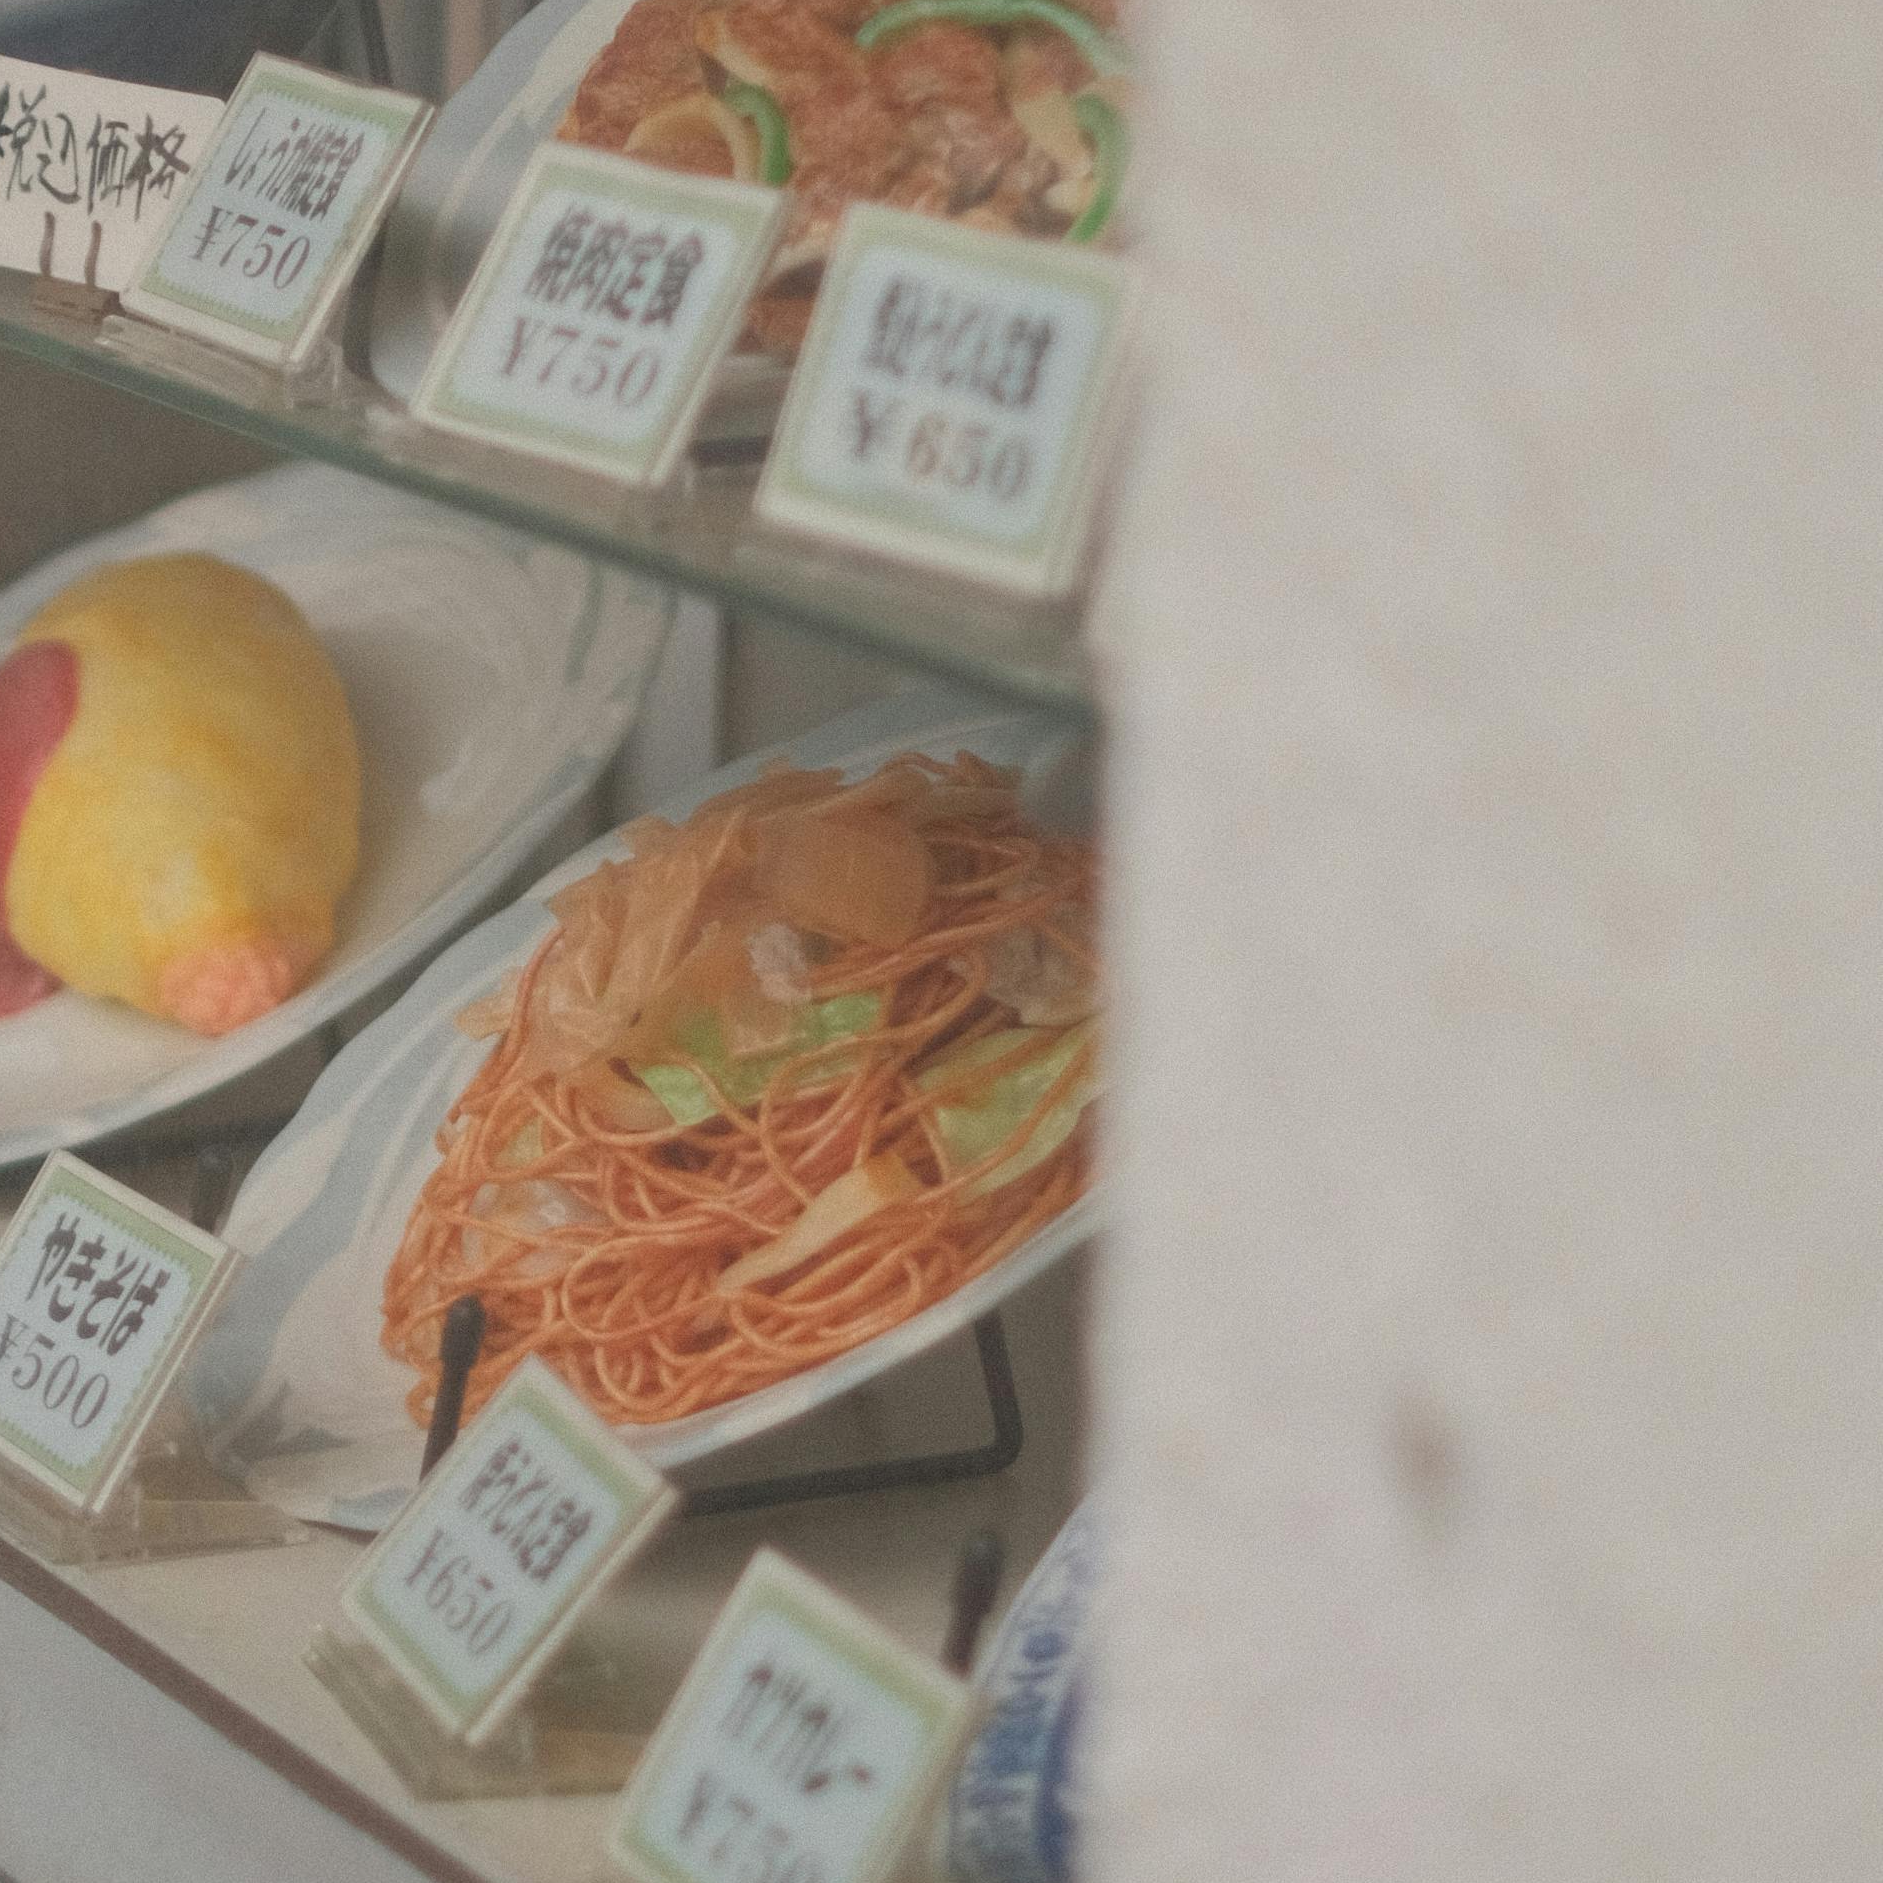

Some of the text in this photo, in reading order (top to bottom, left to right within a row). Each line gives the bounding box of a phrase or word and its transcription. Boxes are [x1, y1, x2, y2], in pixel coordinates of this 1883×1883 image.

[190, 204, 313, 292] ¥750
[496, 316, 662, 409] ¥750
[27, 1212, 171, 1357] やきそば
[404, 1528, 514, 1657] ¥650
